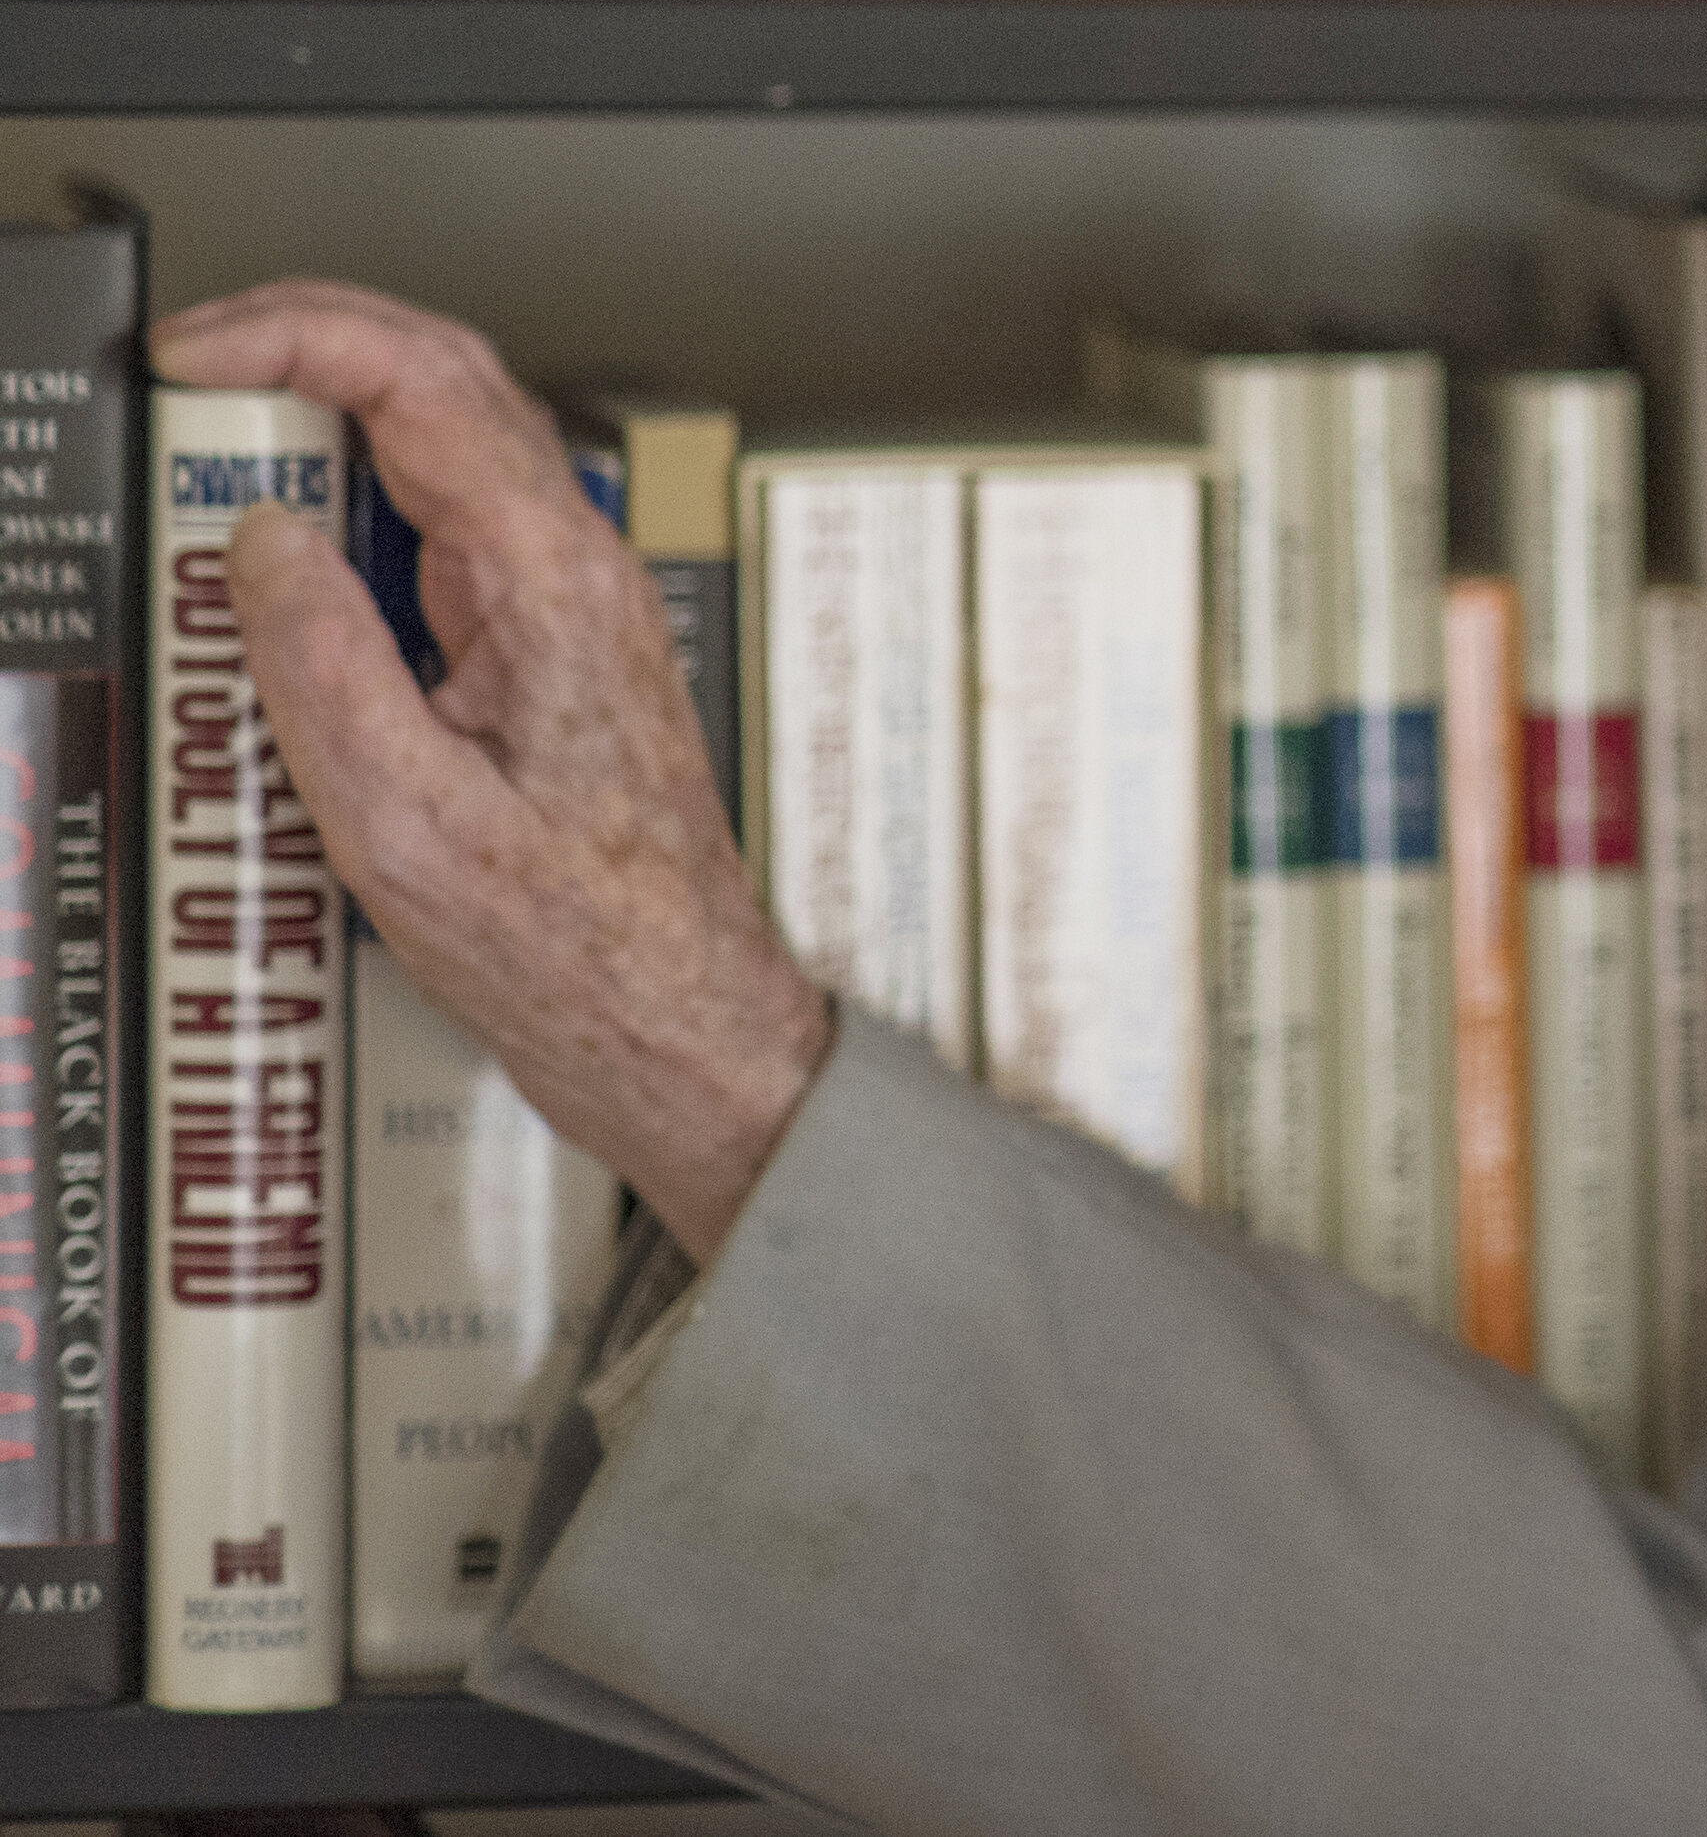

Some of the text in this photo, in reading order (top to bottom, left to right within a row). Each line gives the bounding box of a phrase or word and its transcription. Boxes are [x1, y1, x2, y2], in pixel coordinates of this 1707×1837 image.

[169, 987, 324, 1032] A
[171, 883, 324, 969] OF
[55, 793, 103, 1425] THE BLACK BOOK OF
[169, 1054, 324, 1304] FRIEND
